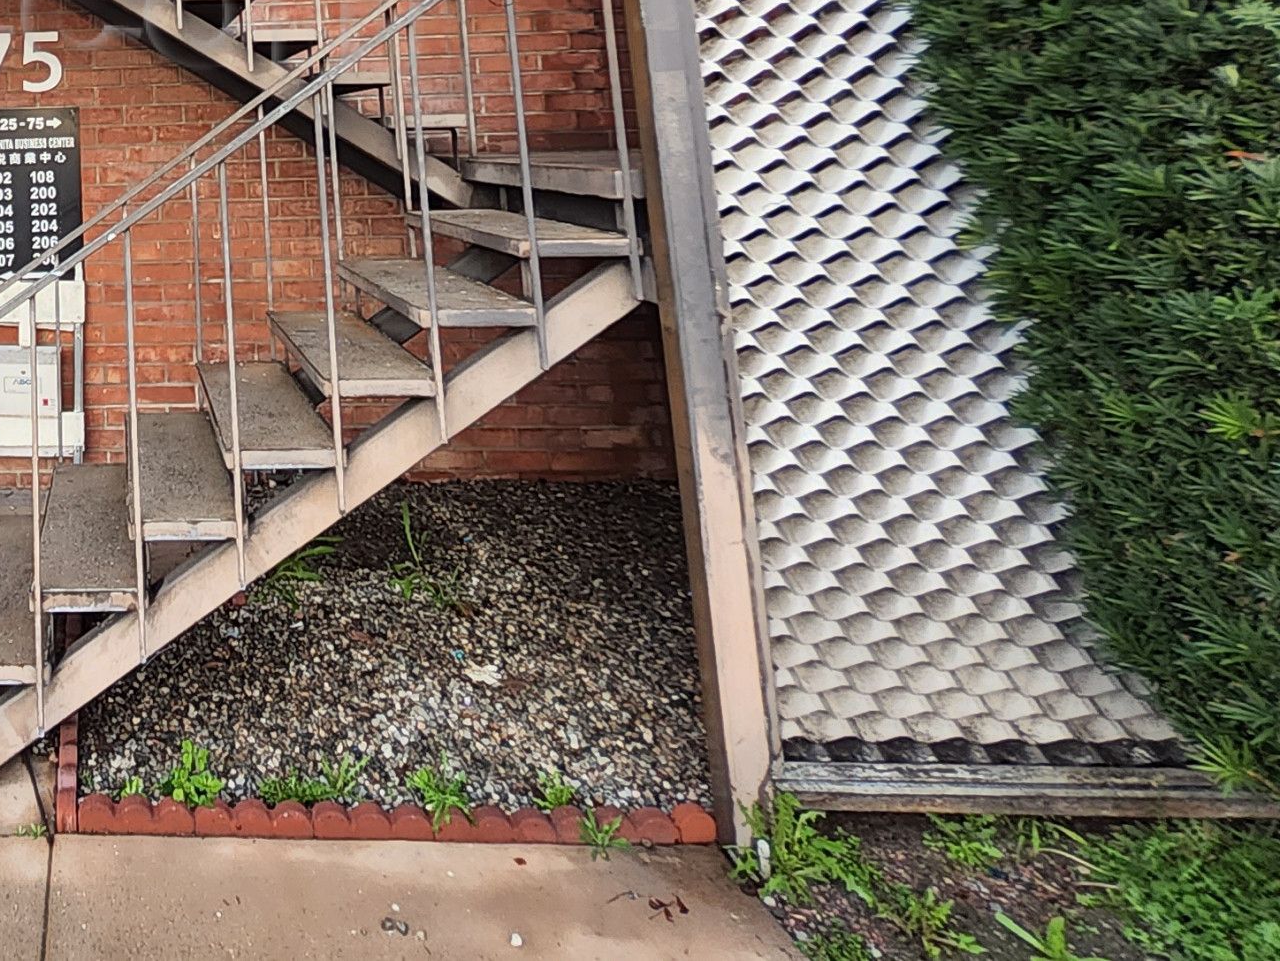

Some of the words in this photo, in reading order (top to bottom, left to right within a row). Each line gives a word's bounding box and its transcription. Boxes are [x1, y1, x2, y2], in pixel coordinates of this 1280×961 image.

[14, 137, 47, 150] BUSINESS
[48, 136, 75, 148] CENTER
[29, 170, 55, 184] 108
[29, 186, 57, 200] 200
[30, 202, 58, 216] 202
[31, 219, 59, 233] 204
